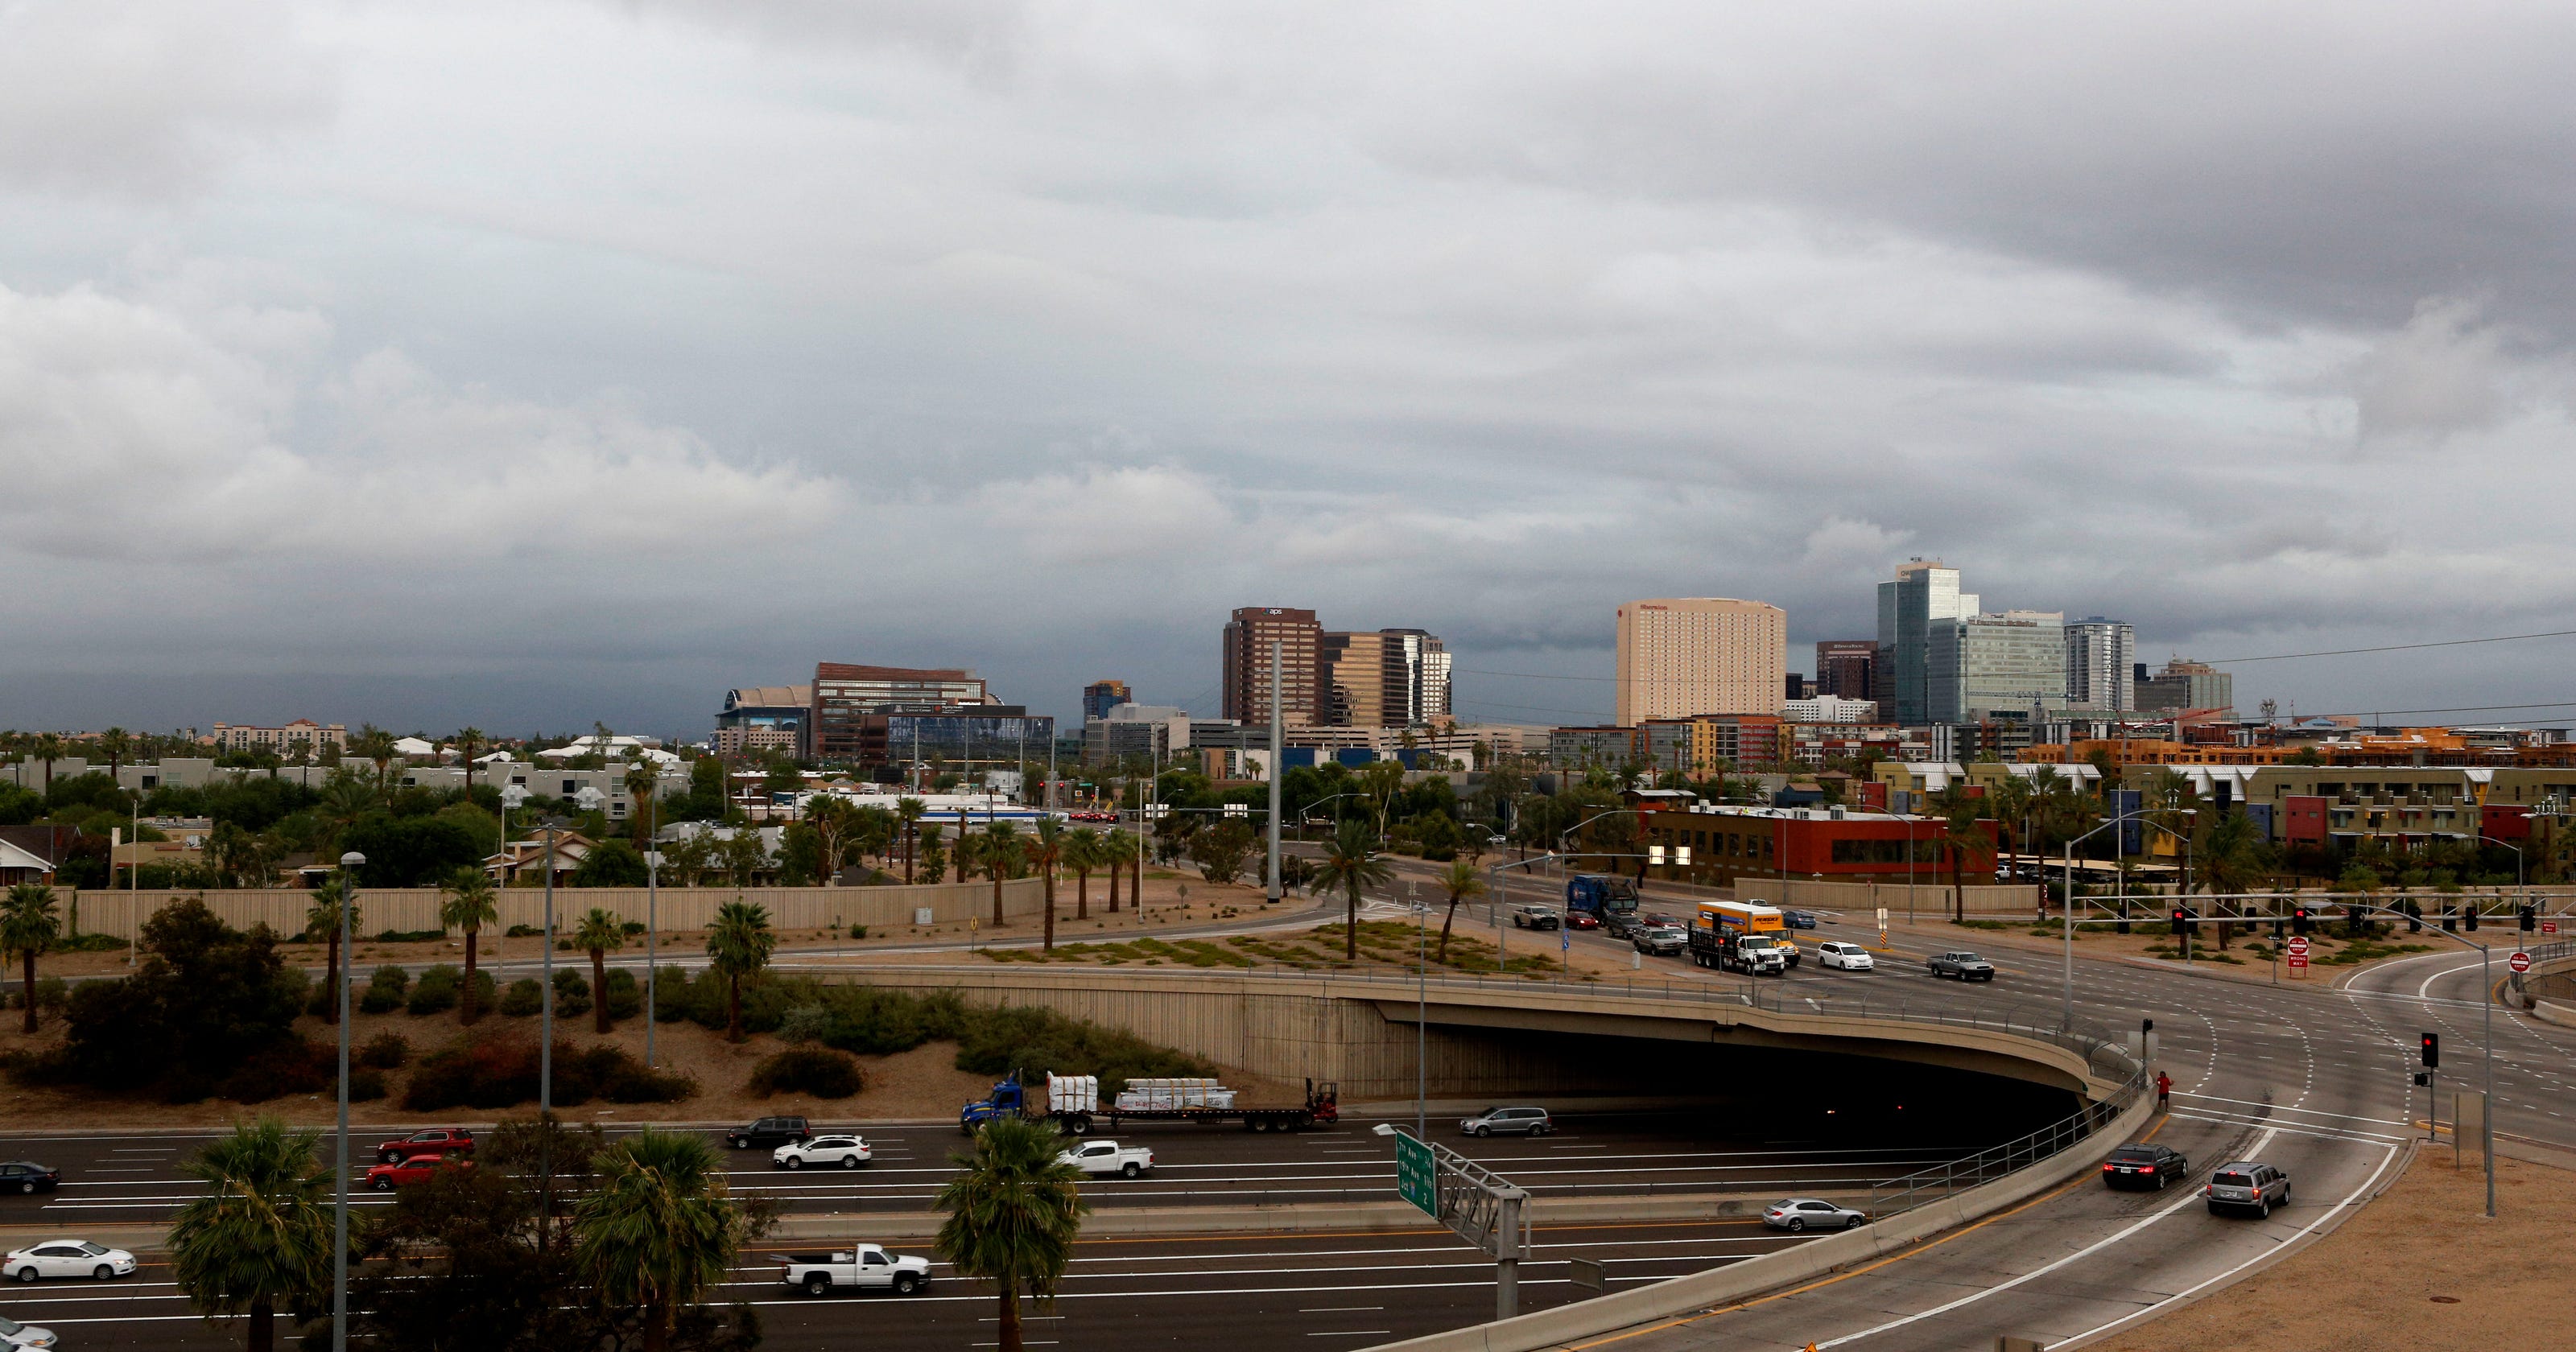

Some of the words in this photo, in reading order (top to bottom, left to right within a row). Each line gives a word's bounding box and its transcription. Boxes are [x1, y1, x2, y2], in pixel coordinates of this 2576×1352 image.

[1408, 1147, 1417, 1160] Ave
[1400, 1160, 1409, 1173] 19th
[1411, 1167, 1419, 1181] Ave
[1423, 1193, 1427, 1205] 2
